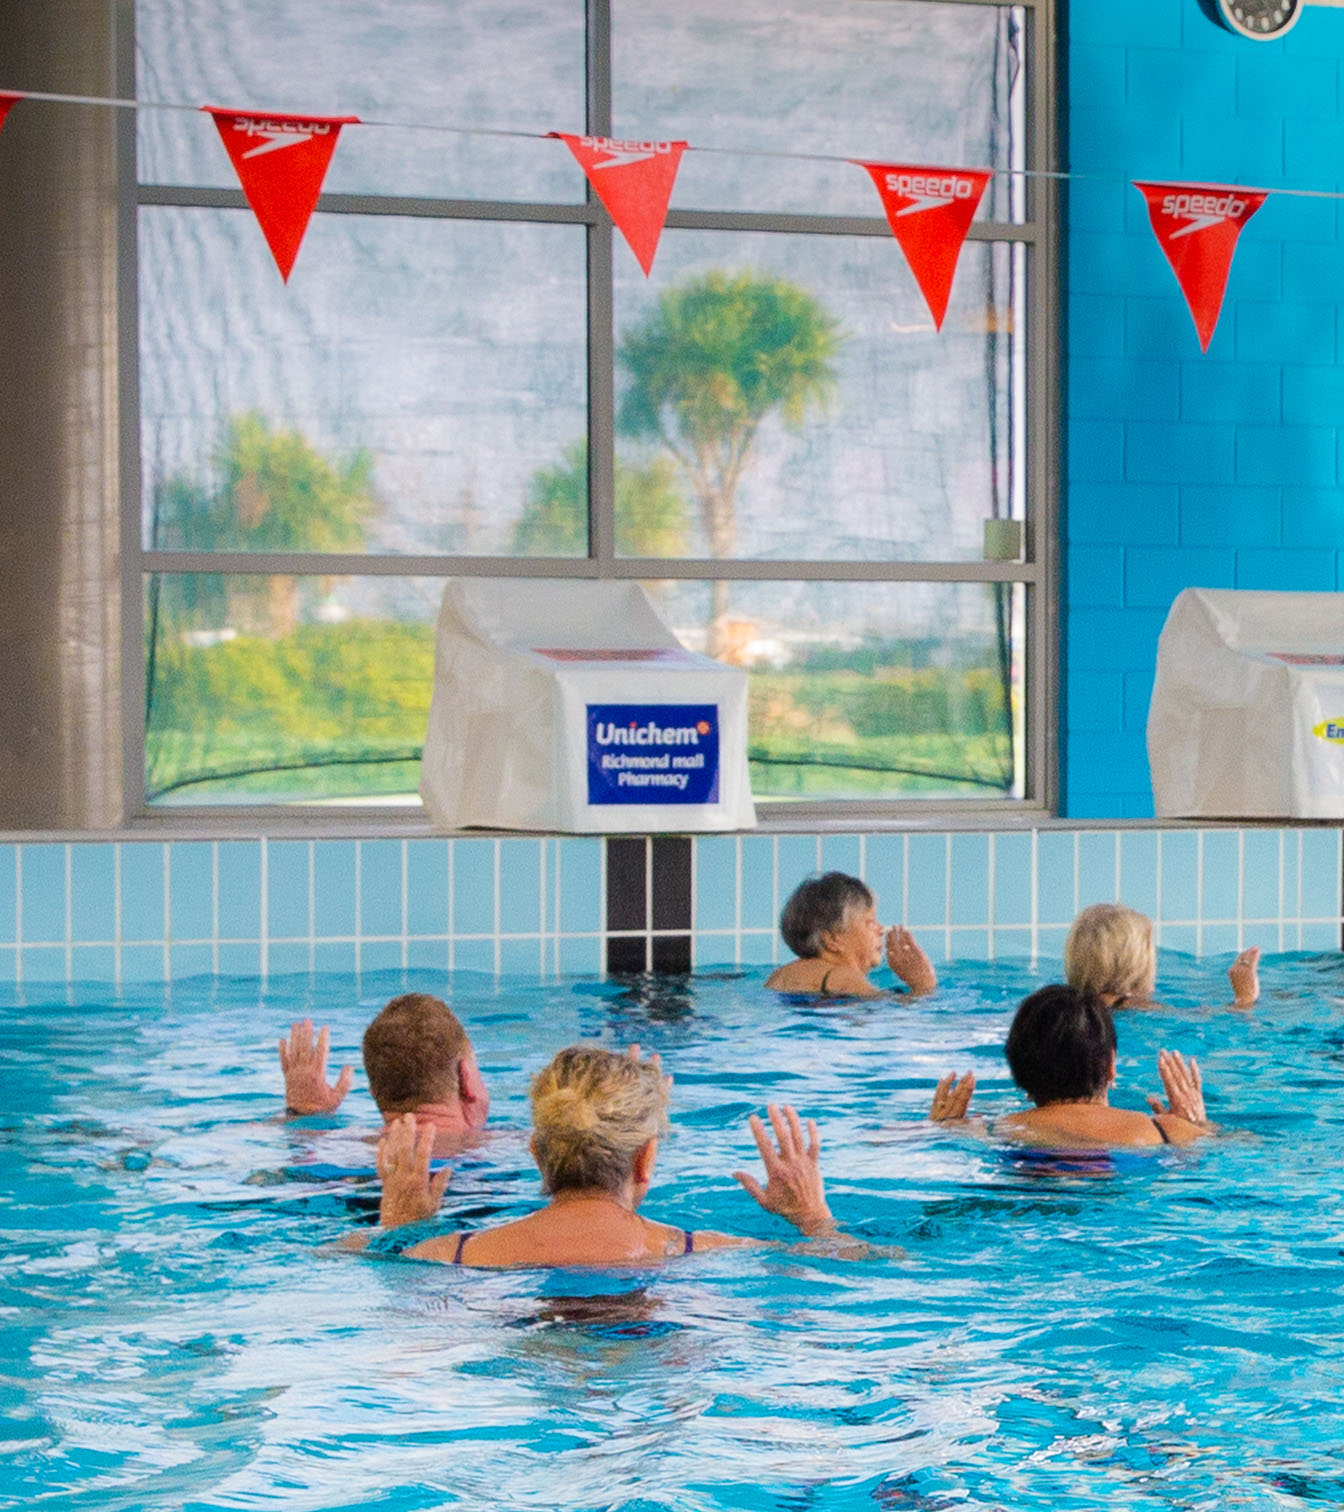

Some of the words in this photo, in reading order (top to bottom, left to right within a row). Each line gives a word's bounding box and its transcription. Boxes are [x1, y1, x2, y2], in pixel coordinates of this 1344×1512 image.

[885, 173, 973, 198] speedo
[1161, 194, 1246, 219] speedo
[595, 721, 699, 746] Unichem
[601, 753, 670, 770] Richmond
[672, 753, 705, 770] mall
[617, 771, 690, 791] Pharmacy
